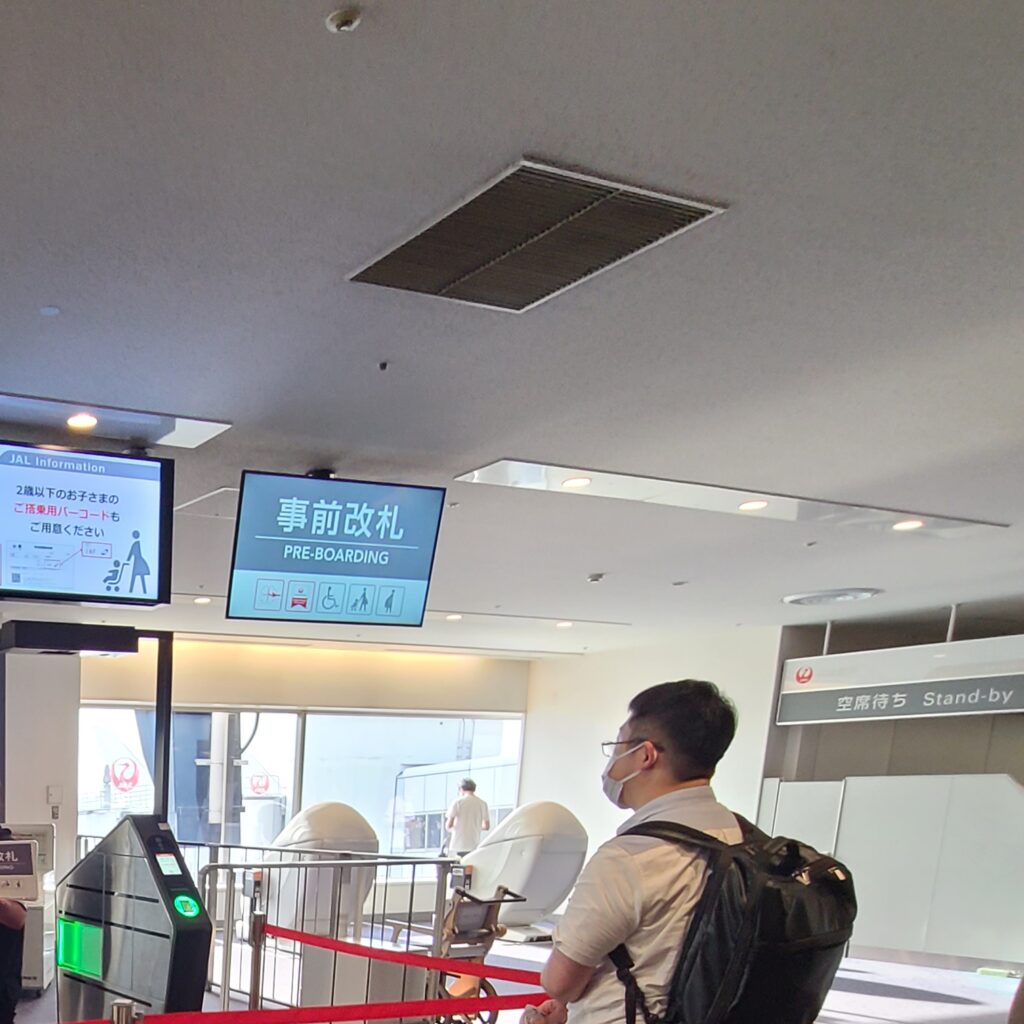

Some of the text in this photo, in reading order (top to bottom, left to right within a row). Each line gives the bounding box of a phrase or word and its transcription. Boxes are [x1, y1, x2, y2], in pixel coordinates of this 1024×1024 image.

[9, 453, 106, 473] JAL Information
[16, 485, 120, 505] 2歳以下のお子さまの
[14, 502, 120, 522] ご搭乗用バーコードも
[277, 497, 404, 540] 事前改札
[30, 522, 105, 538] ご用意ください
[283, 544, 390, 565] PRE-BOARDING
[835, 687, 1014, 712] 空席待ち Stand-by
